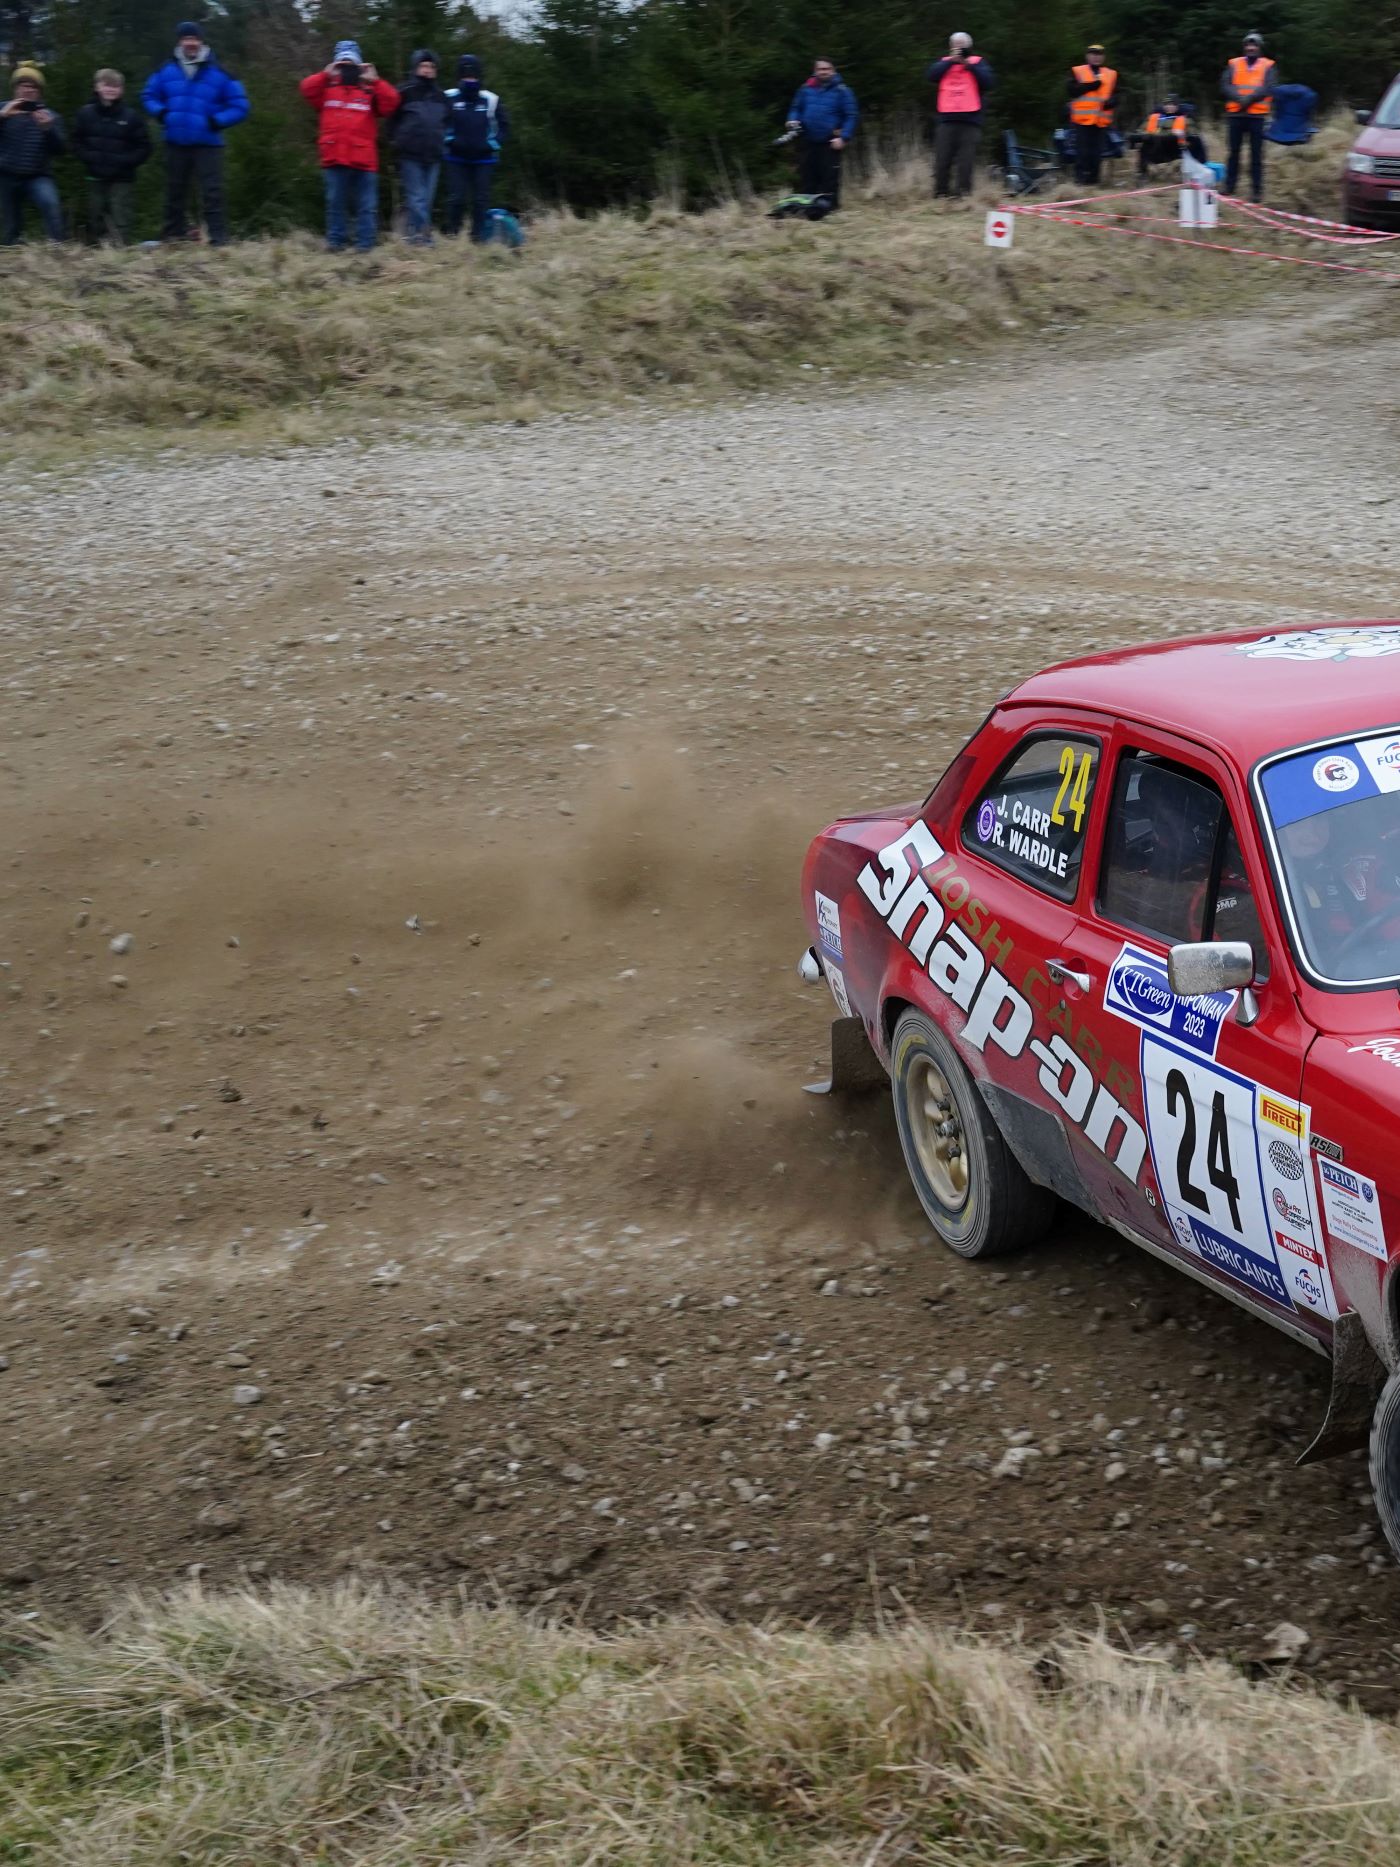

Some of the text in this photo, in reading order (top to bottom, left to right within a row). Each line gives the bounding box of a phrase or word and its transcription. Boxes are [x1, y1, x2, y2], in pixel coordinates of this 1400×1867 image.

[1051, 747, 1092, 832] 24
[997, 794, 1008, 818] J.
[1012, 800, 1051, 838] CARR
[992, 821, 1069, 878] R. WARDLE
[924, 856, 1137, 1101] JOSH CARR
[1183, 1012, 1206, 1038] 2023
[1263, 1099, 1302, 1133] PIRELLI
[1166, 1068, 1243, 1234] 24
[1329, 1167, 1358, 1191] PETCH
[1193, 1228, 1285, 1297] LUBRICANTS
[1283, 1236, 1315, 1261] MINTEX
[1295, 1276, 1321, 1298] FUCHS
